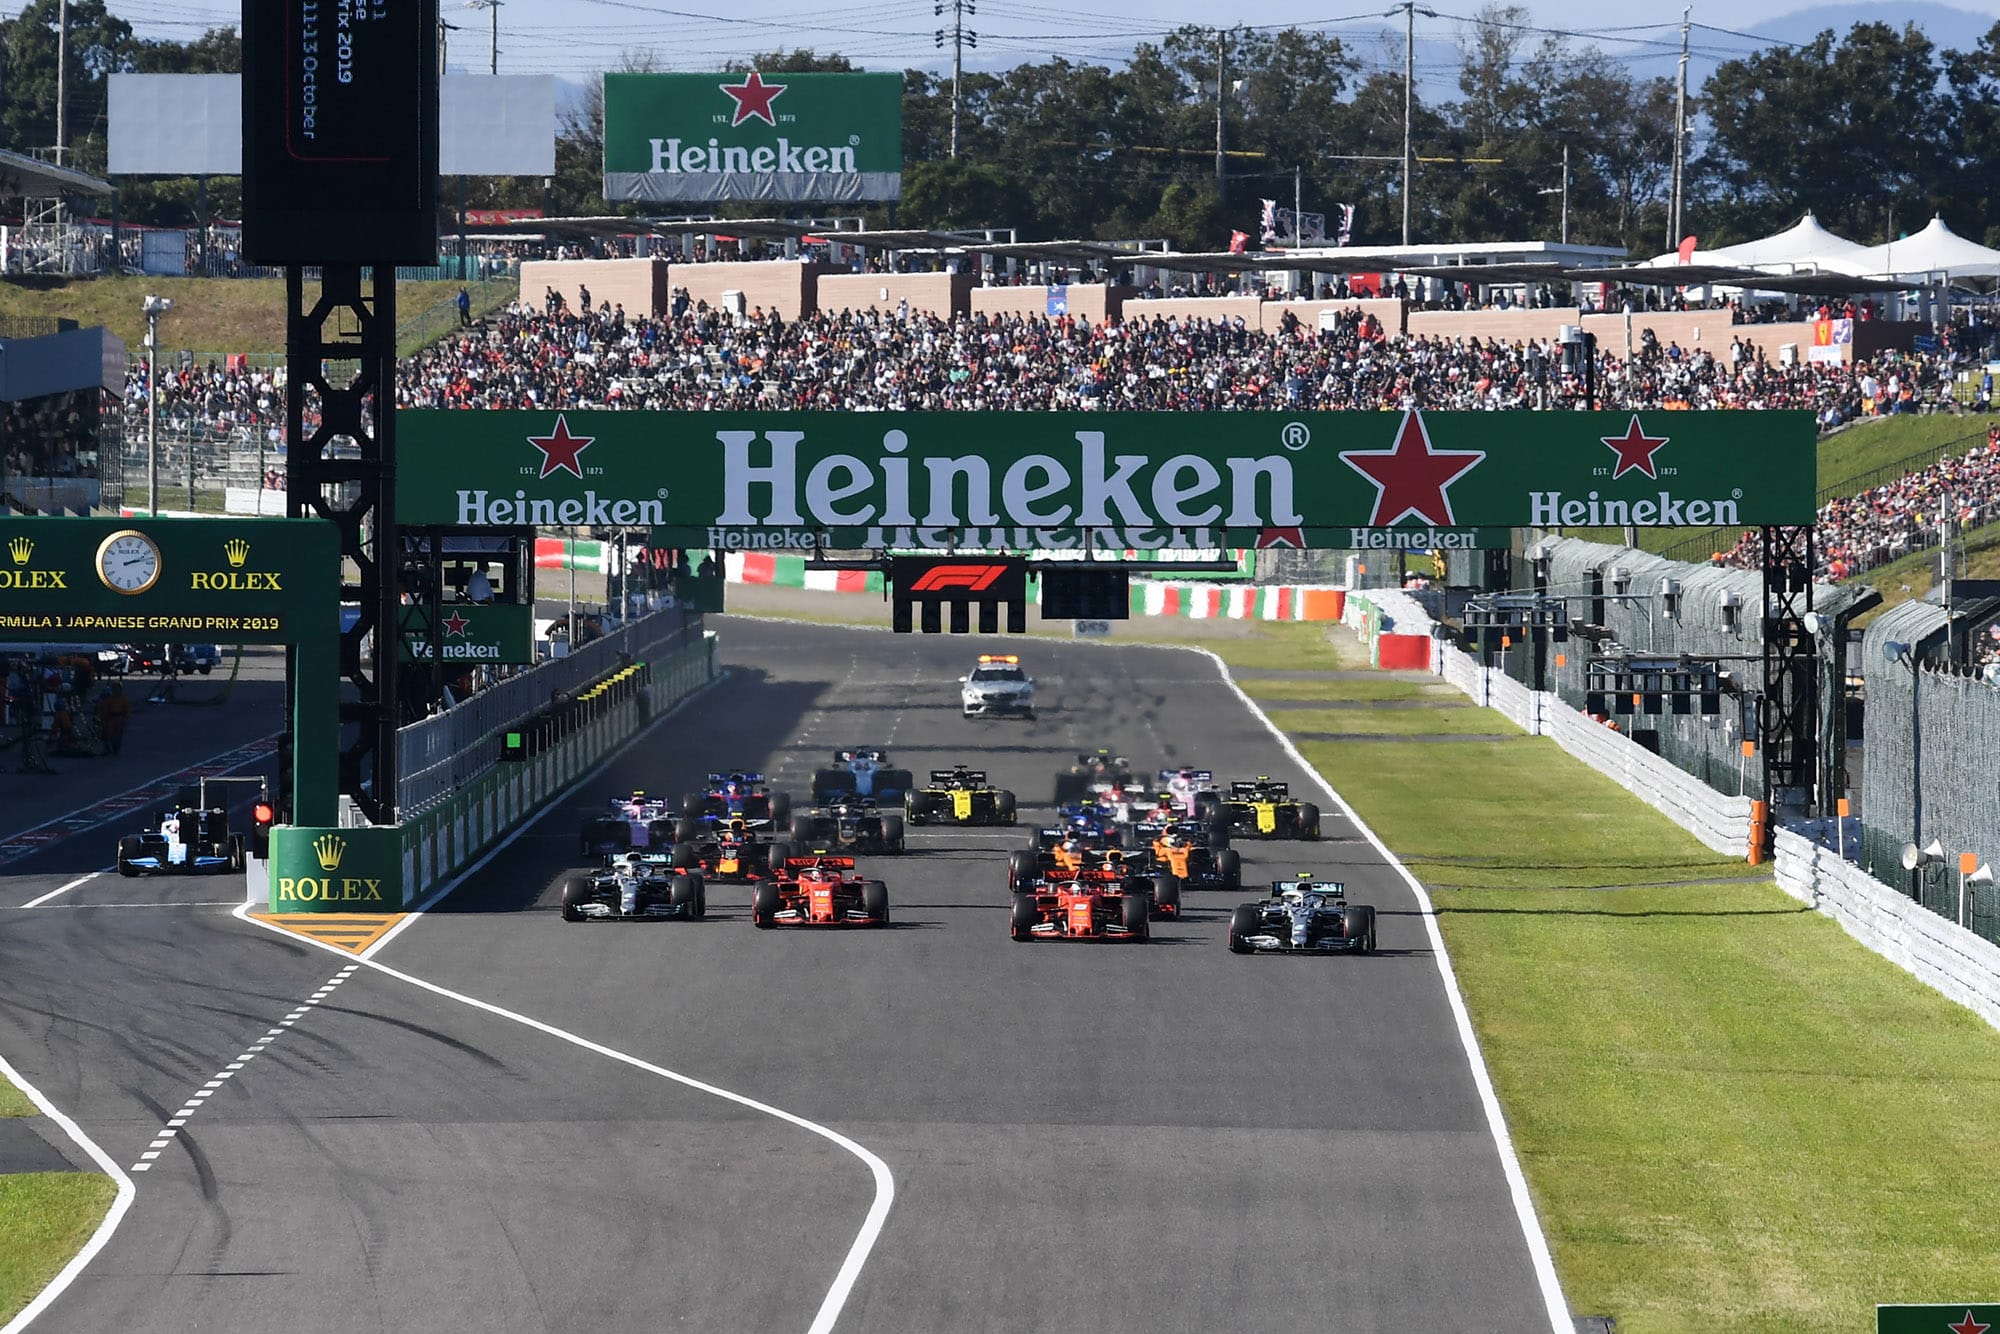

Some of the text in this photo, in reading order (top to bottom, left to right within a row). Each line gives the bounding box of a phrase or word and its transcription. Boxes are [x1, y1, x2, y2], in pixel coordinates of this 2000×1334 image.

[337, 32, 353, 84] 2019
[303, 56, 318, 139] October
[191, 572, 282, 590] ROLEX
[55, 616, 62, 627] 1
[66, 616, 145, 629] JAPANESE
[148, 617, 203, 629] GRAND
[205, 617, 240, 629] PRIX
[242, 617, 279, 630] 2019
[412, 641, 500, 658] Heneken
[278, 877, 382, 902] ROLEX
